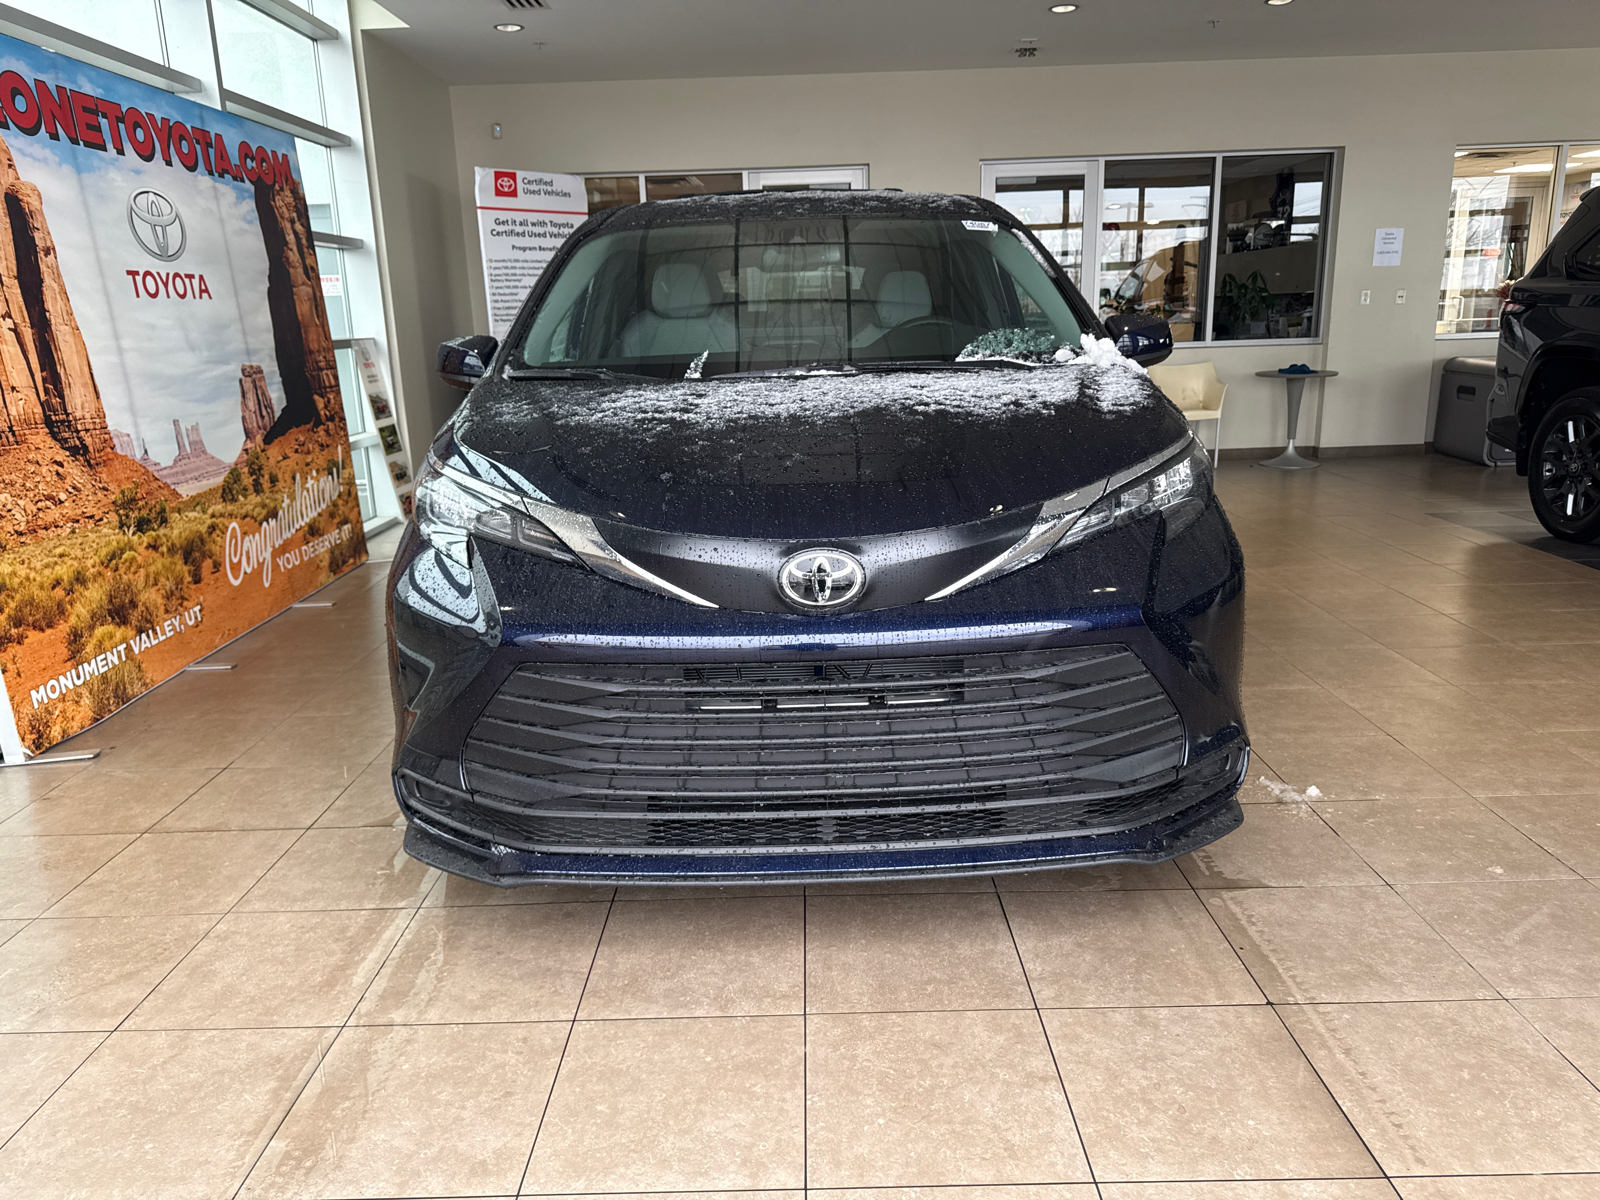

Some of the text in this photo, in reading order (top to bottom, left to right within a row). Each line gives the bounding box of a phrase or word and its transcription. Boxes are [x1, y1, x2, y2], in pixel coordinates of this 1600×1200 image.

[0, 69, 295, 191] ONETOYOTA.COM
[522, 177, 554, 187] Certified
[523, 187, 572, 198] Used Vehicles
[490, 228, 526, 238] Certified
[527, 230, 547, 238] Used
[494, 217, 574, 230] Get it all with Toyota
[511, 244, 537, 252] Program
[125, 269, 213, 300] TOYOTA
[225, 444, 344, 588] Congratulations!
[276, 523, 353, 572] YOU DESERVE IT!
[29, 604, 202, 710] MONUMENT VALLEY, UT
